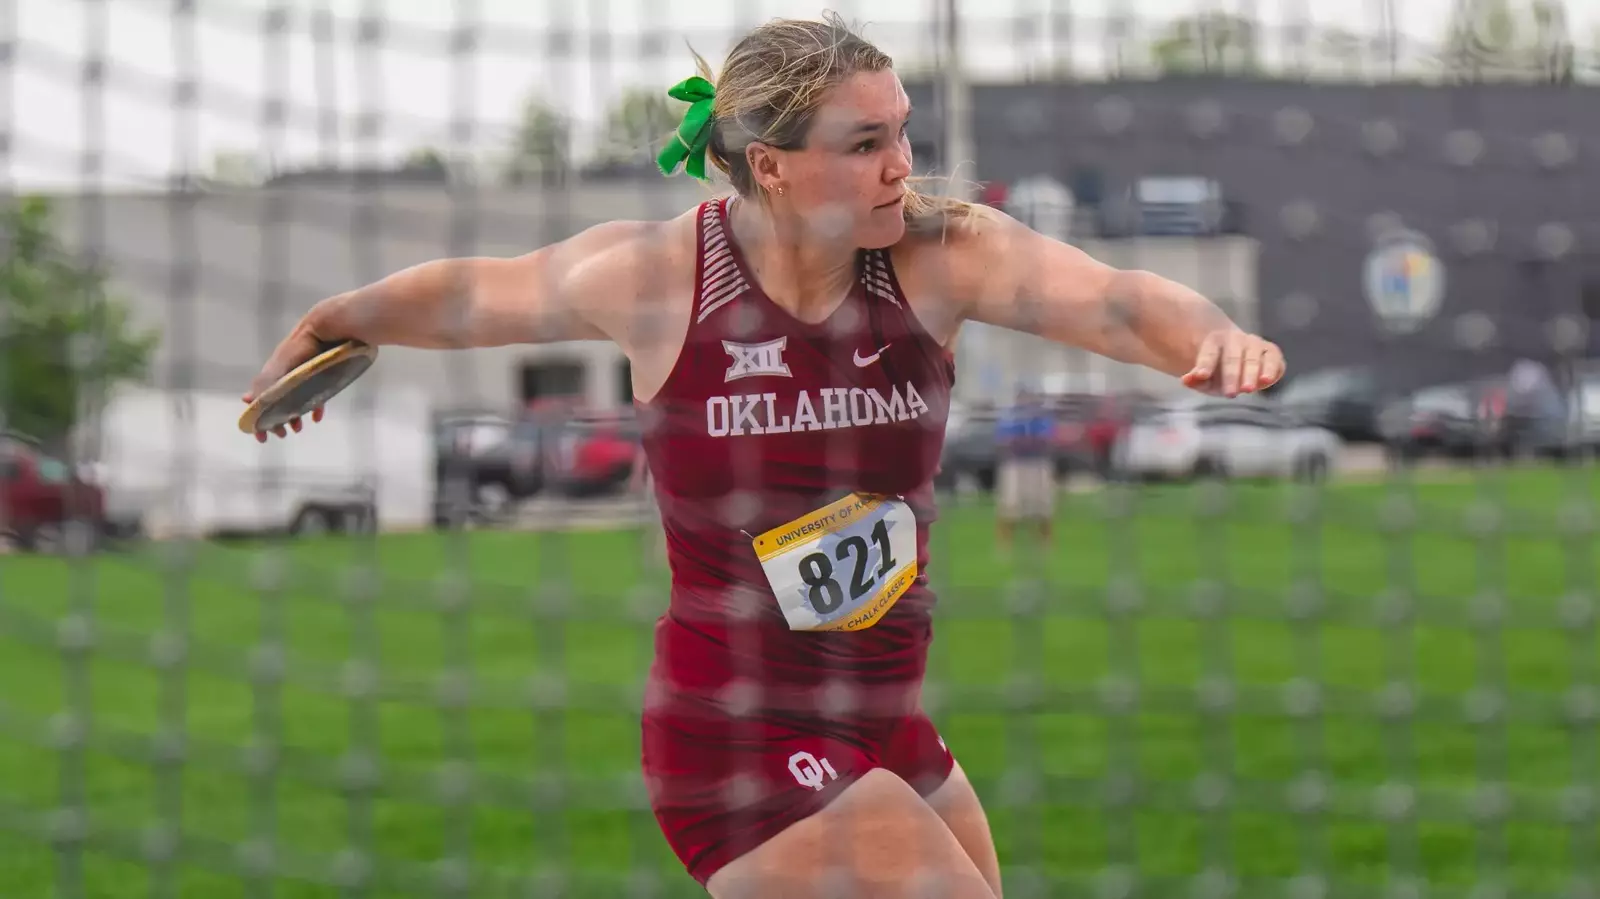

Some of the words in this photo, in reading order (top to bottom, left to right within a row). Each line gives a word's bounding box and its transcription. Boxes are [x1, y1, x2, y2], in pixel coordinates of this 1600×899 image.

[706, 380, 929, 437] OKLAHOMA
[776, 514, 836, 546] UNIVERSITY
[839, 506, 852, 518] OF
[799, 519, 896, 615] 821
[848, 605, 878, 628] CHALK
[880, 577, 905, 607] CLASSIC
